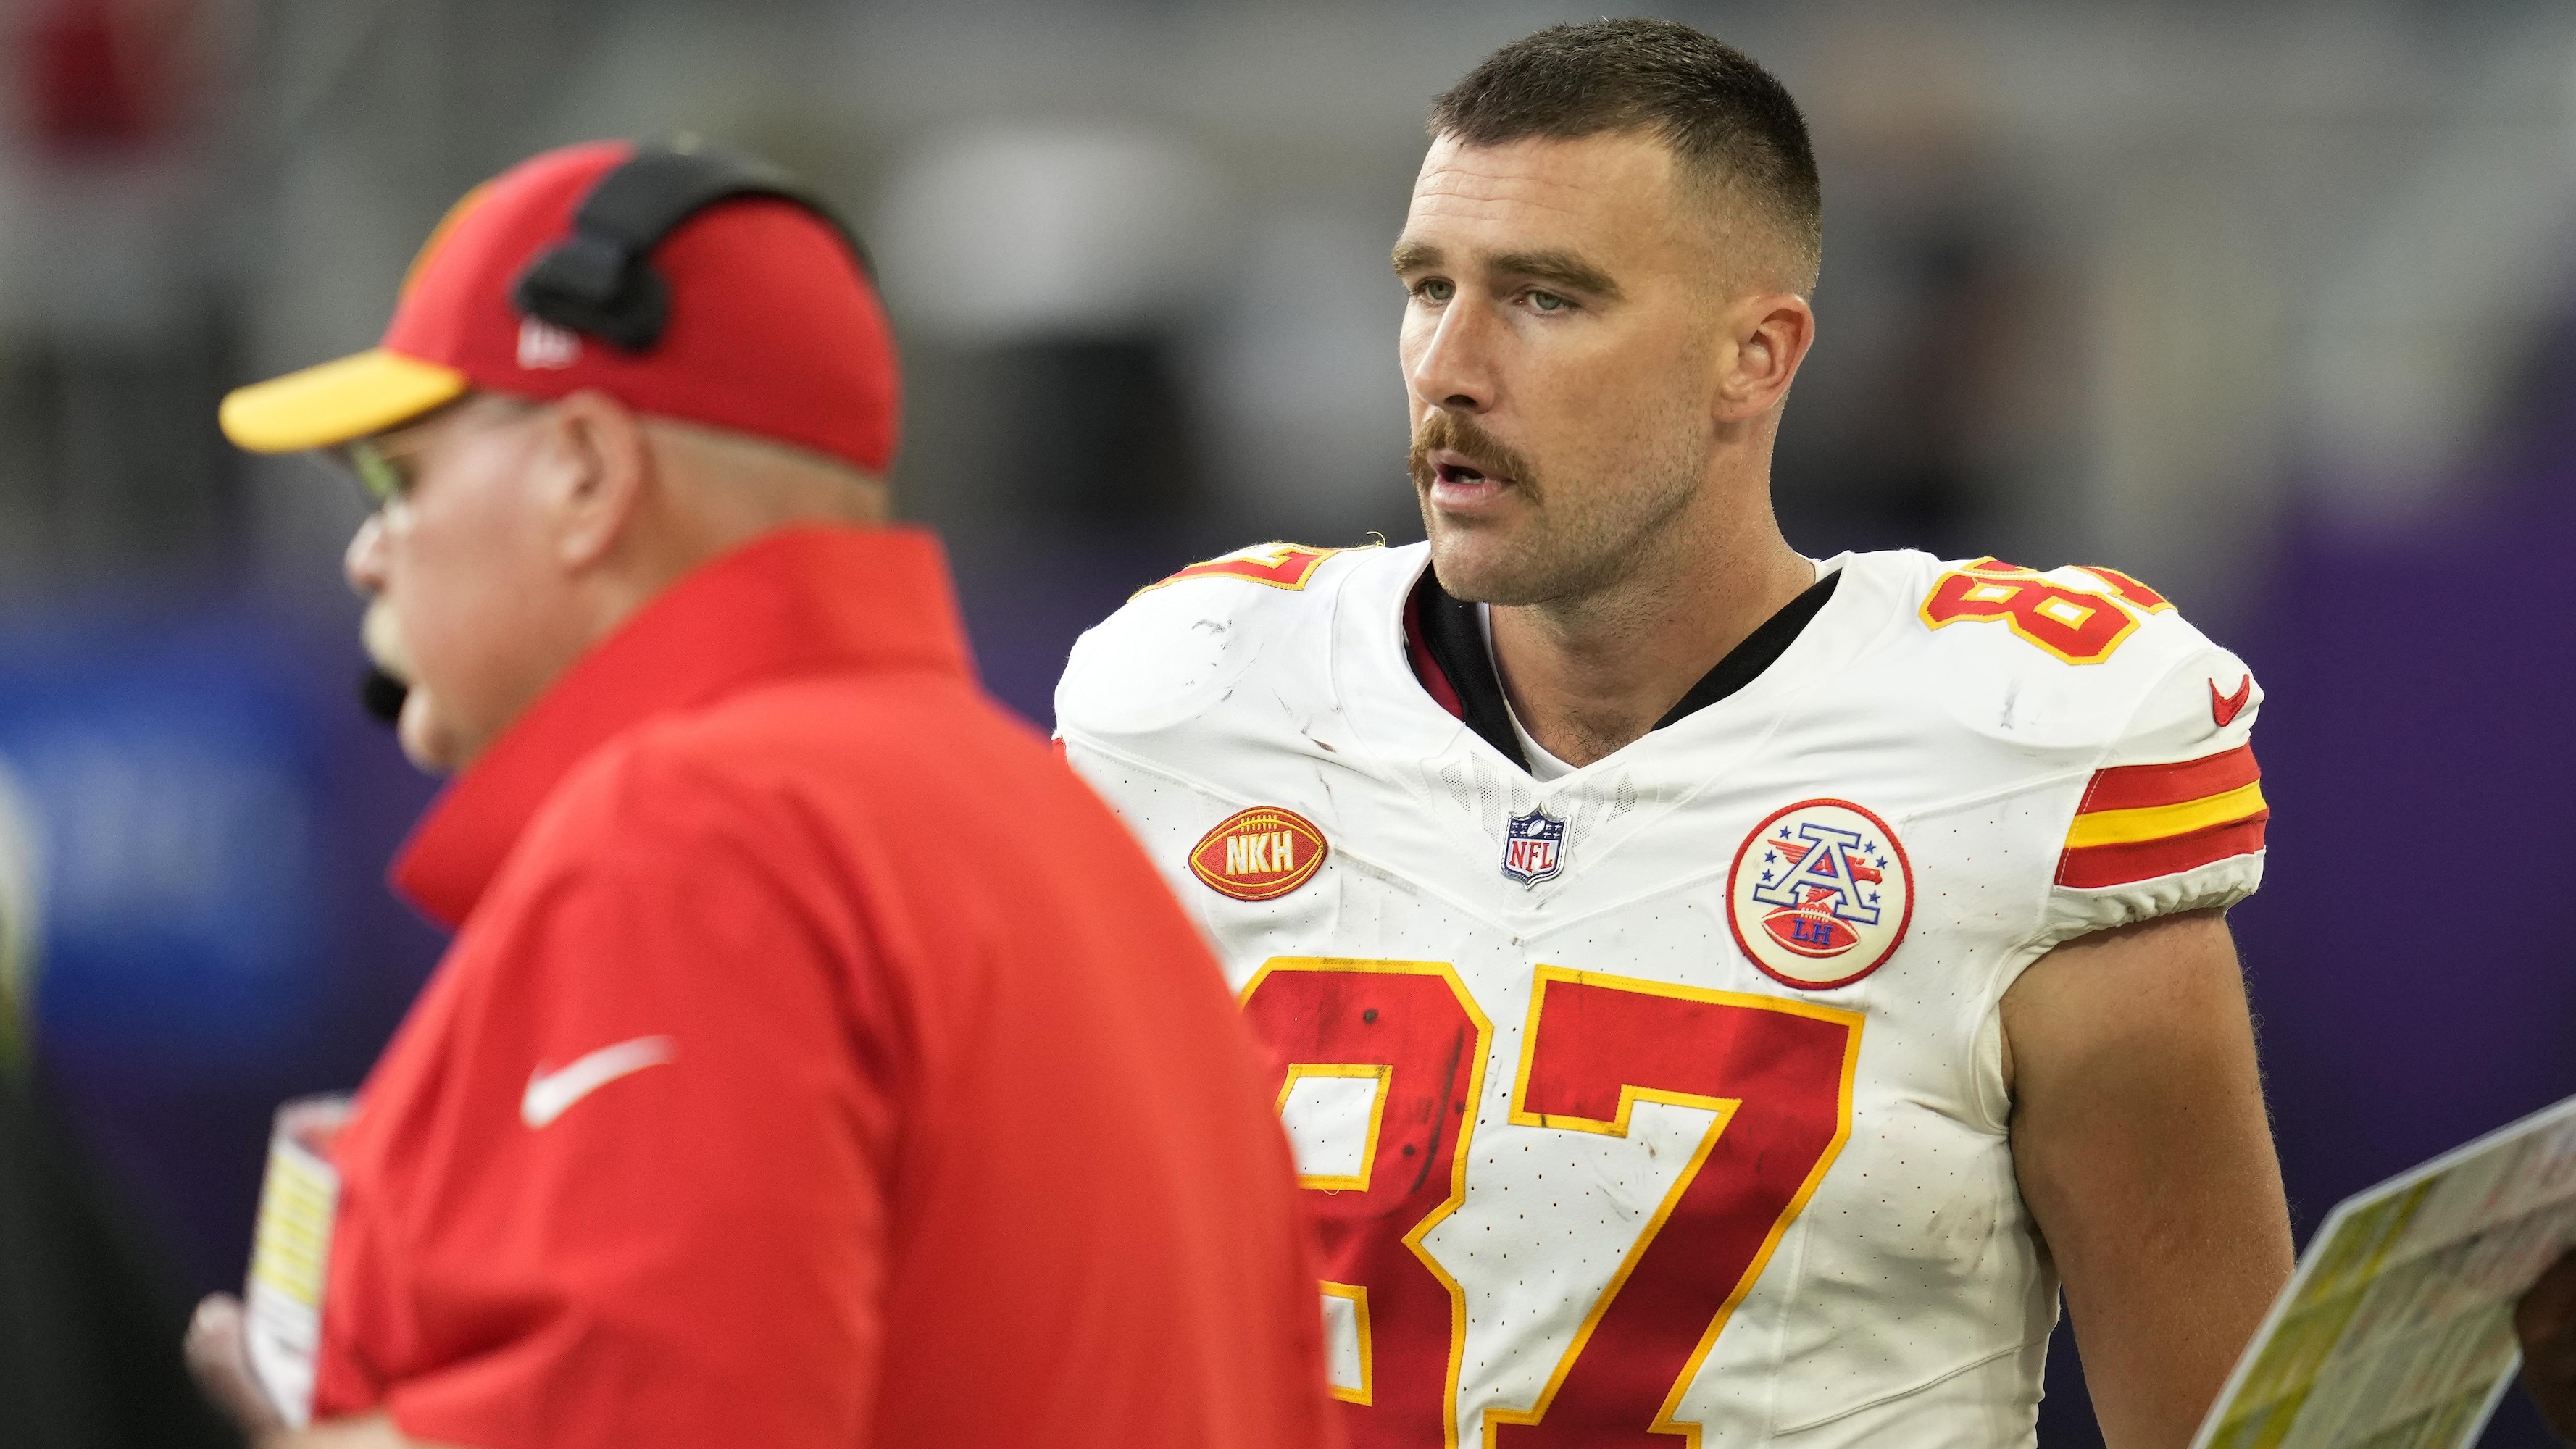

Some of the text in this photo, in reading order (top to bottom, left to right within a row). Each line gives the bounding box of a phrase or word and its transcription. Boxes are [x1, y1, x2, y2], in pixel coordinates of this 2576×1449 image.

[1225, 830, 1294, 876] NKH
[1509, 840, 1553, 873] NFL
[1752, 822, 1880, 925] A
[1791, 917, 1833, 945] LH
[1238, 956, 1865, 1449] 87
